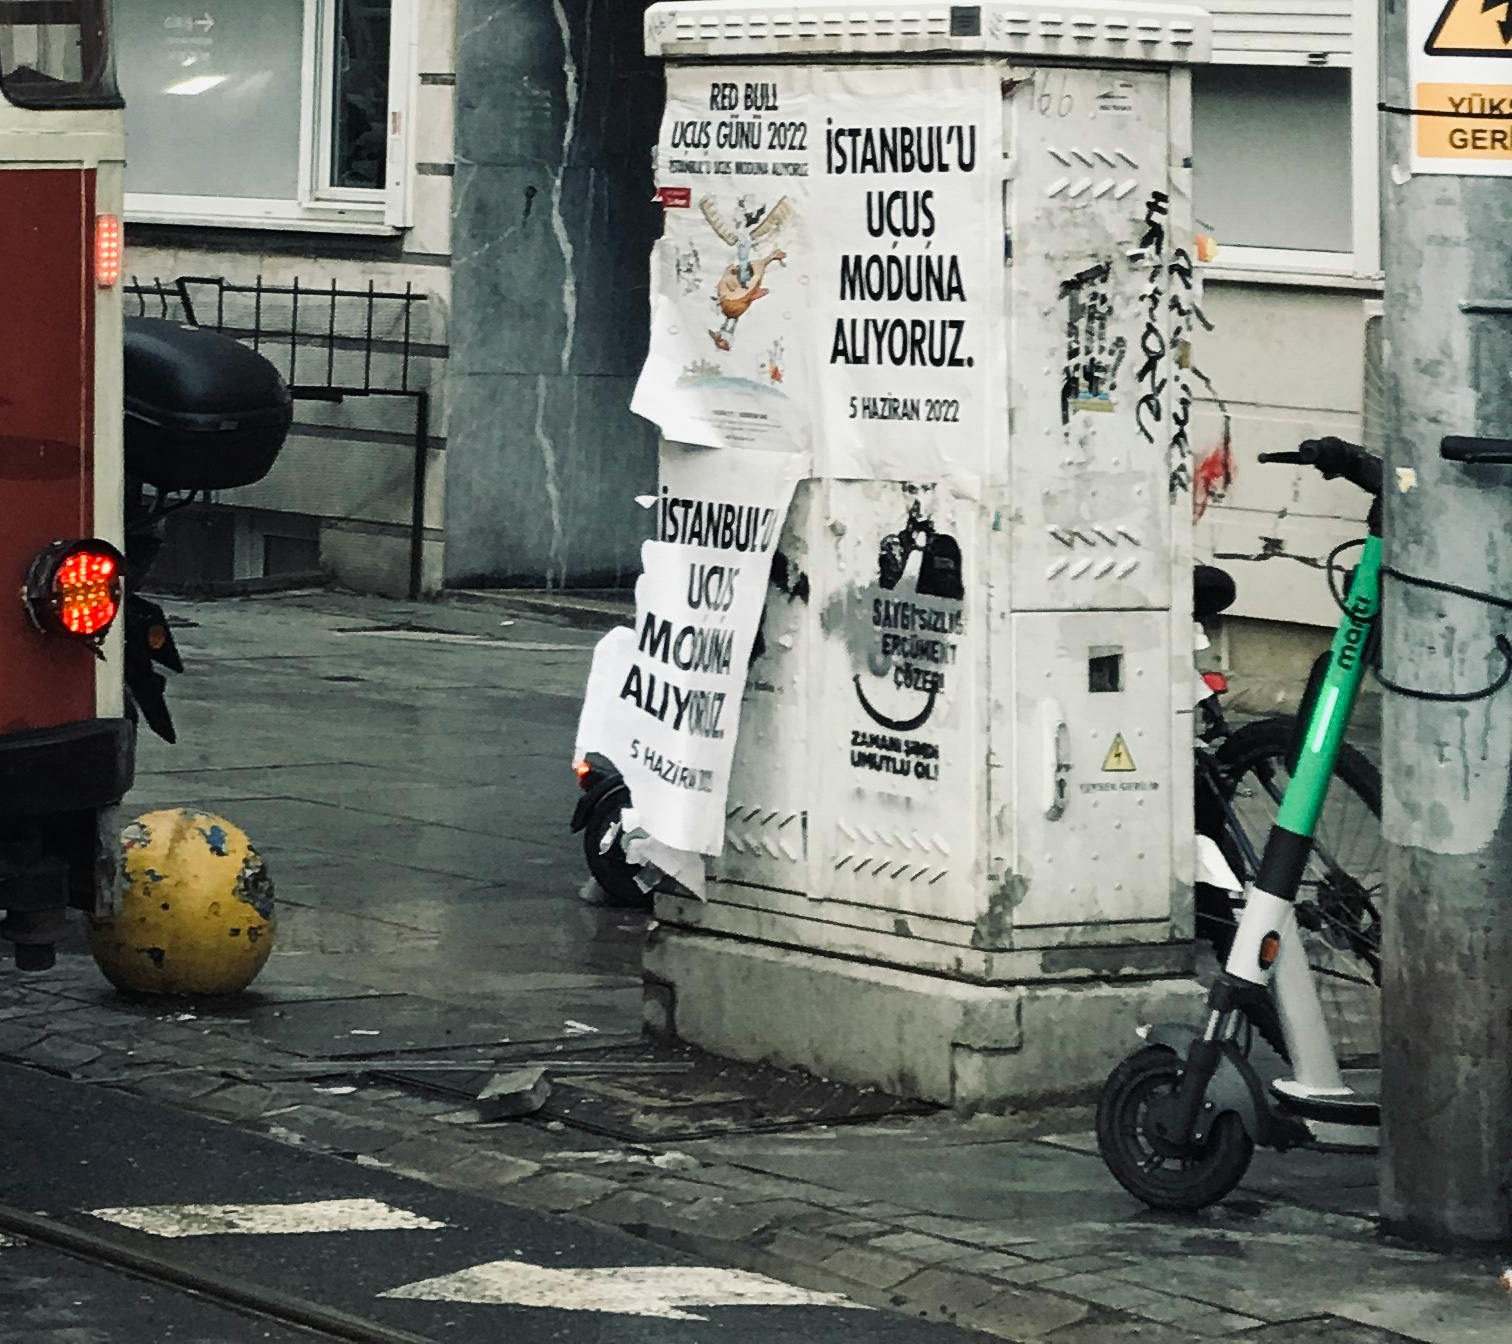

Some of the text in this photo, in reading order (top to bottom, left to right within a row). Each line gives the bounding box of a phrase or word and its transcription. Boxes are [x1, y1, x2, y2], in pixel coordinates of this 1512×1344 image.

[710, 83, 778, 111] RED BULL
[716, 114, 762, 150] GÜNÜ
[767, 121, 807, 151] 2022
[826, 117, 976, 175] İSTANBUL'U
[866, 190, 936, 249] UÇUŞ
[839, 254, 967, 302] MODUNA
[829, 318, 974, 368] ALIYORUZ.
[849, 392, 961, 422] 5 HAZİRAN 2022
[630, 739, 641, 760] 5
